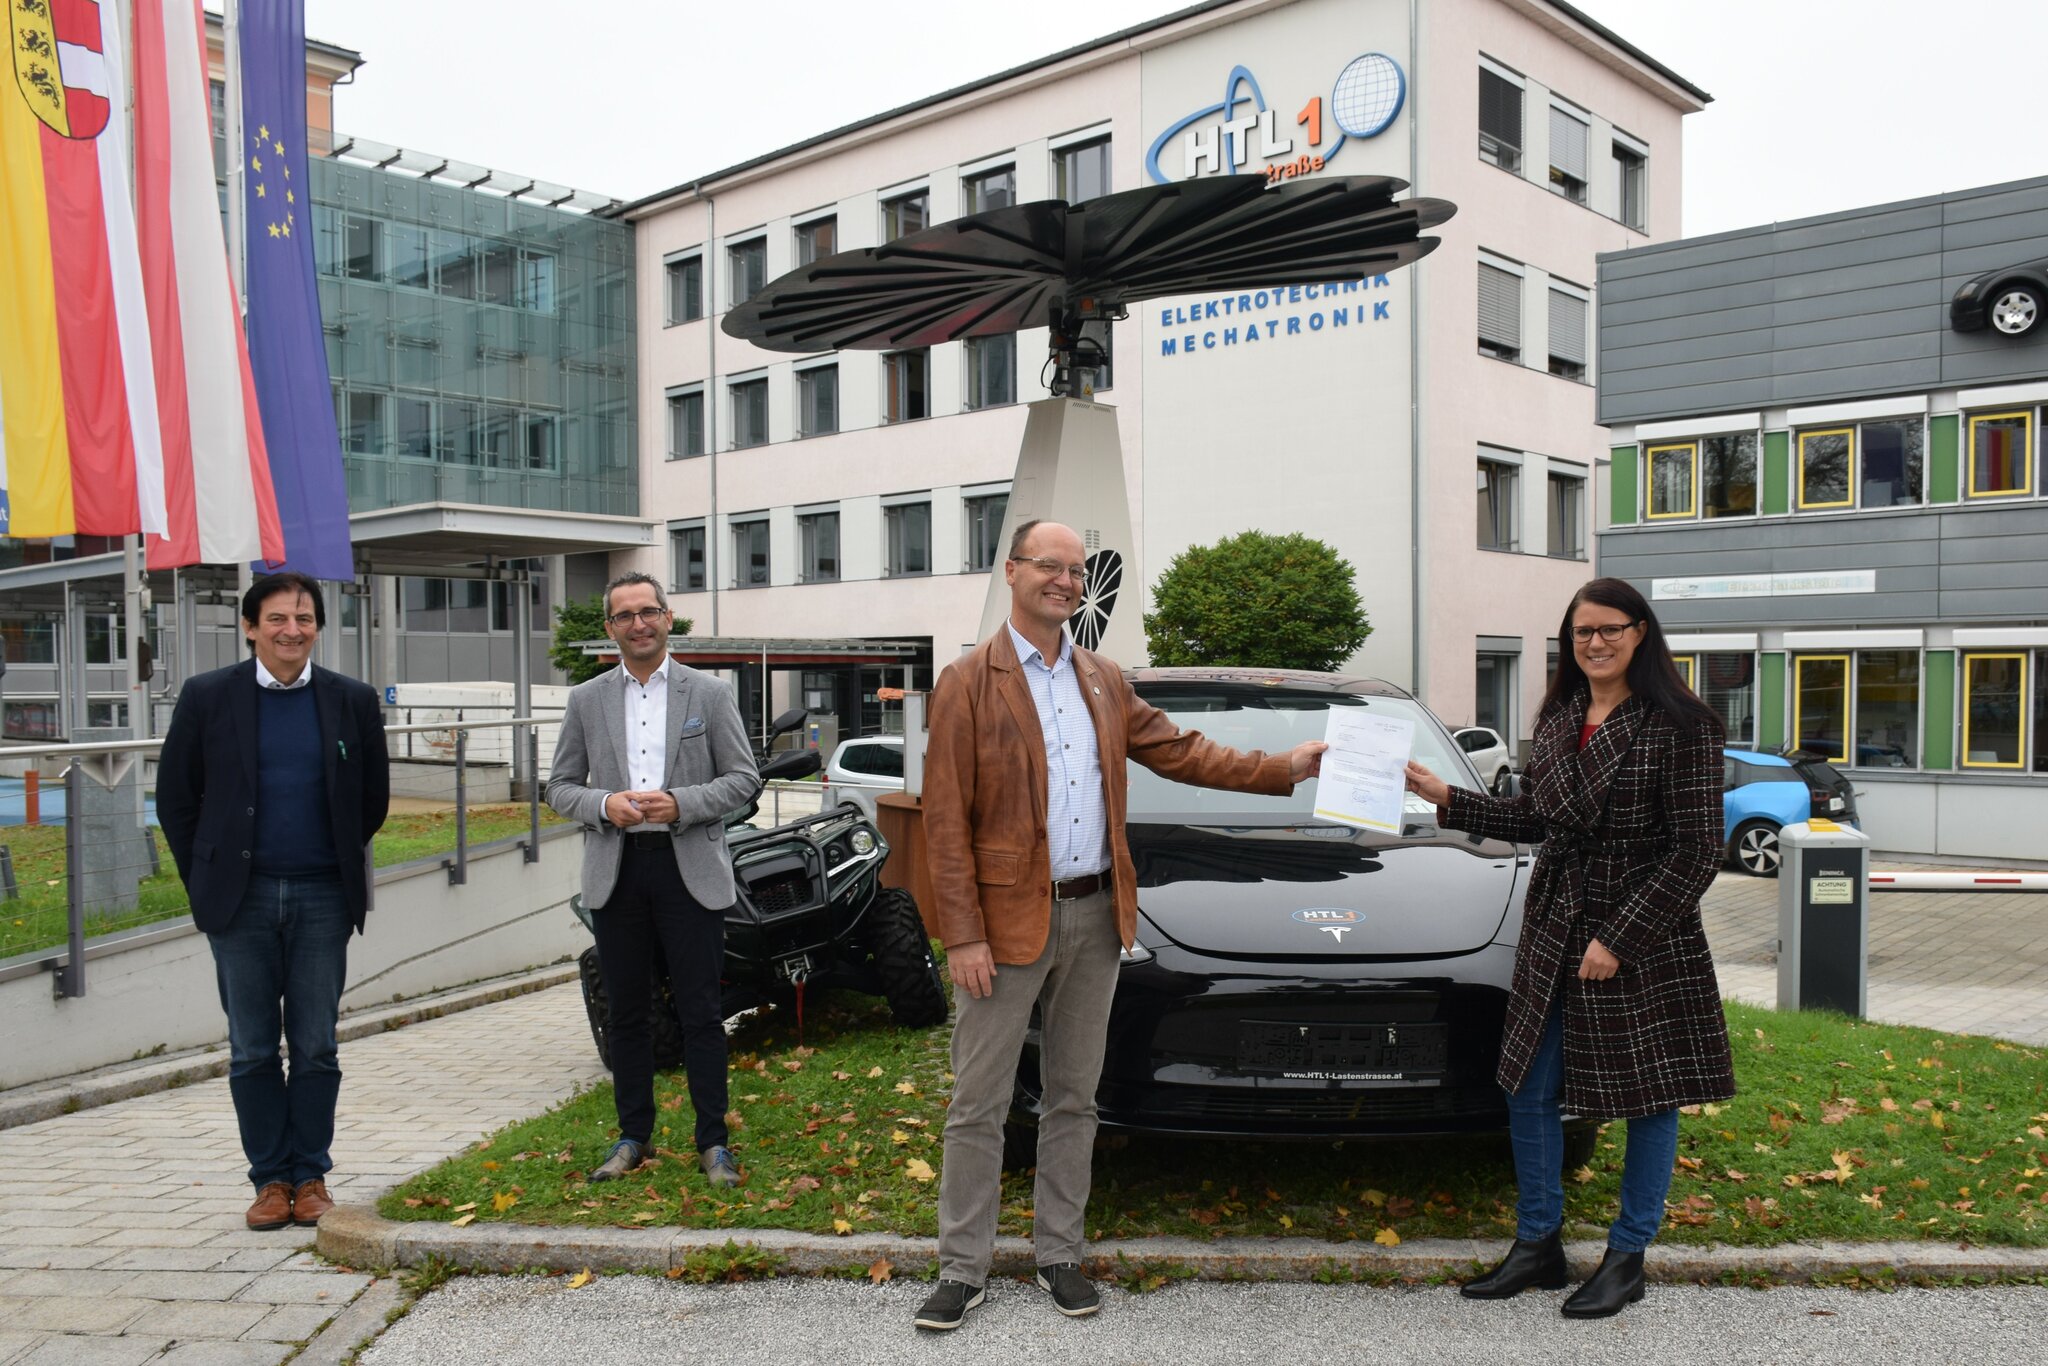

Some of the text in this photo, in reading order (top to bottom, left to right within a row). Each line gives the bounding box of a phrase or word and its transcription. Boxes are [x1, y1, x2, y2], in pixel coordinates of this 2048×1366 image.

[1161, 273, 1390, 327] ELEKTROTECHNIK
[1161, 300, 1390, 357] MECHATRONIK
[1283, 1071, 1403, 1080] www.HTL1-Lastenstrasse.at
